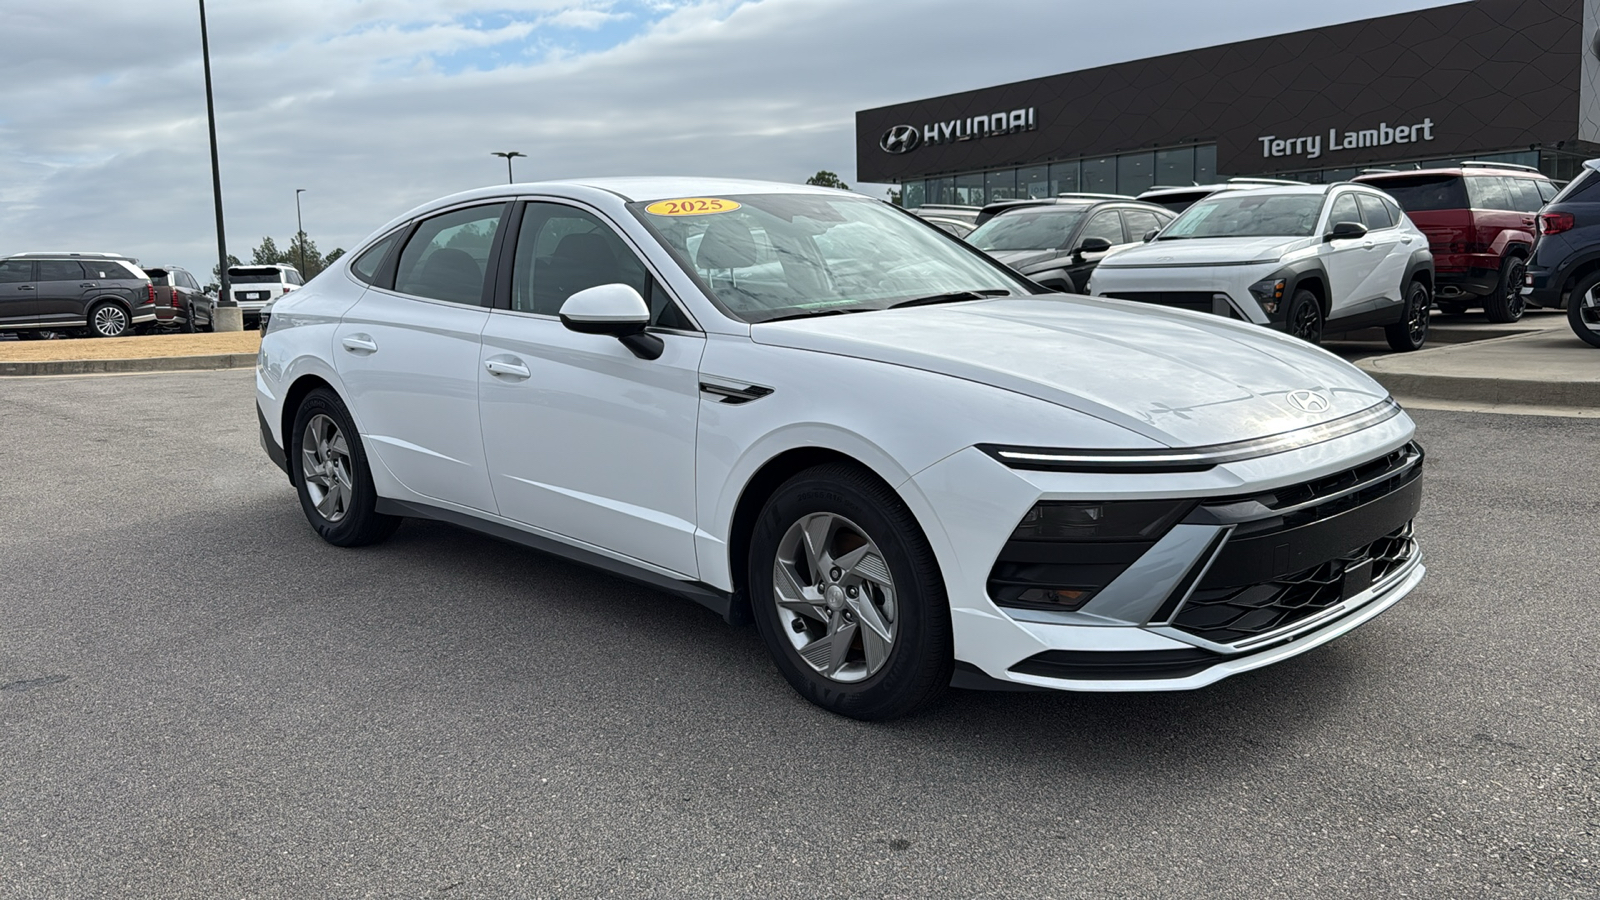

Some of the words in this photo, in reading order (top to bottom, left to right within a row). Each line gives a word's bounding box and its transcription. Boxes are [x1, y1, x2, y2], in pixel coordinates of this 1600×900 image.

[924, 107, 1036, 146] HYUNDAI
[1258, 135, 1321, 159] Terry
[1329, 117, 1434, 151] Lambert
[665, 199, 723, 214] 2025
